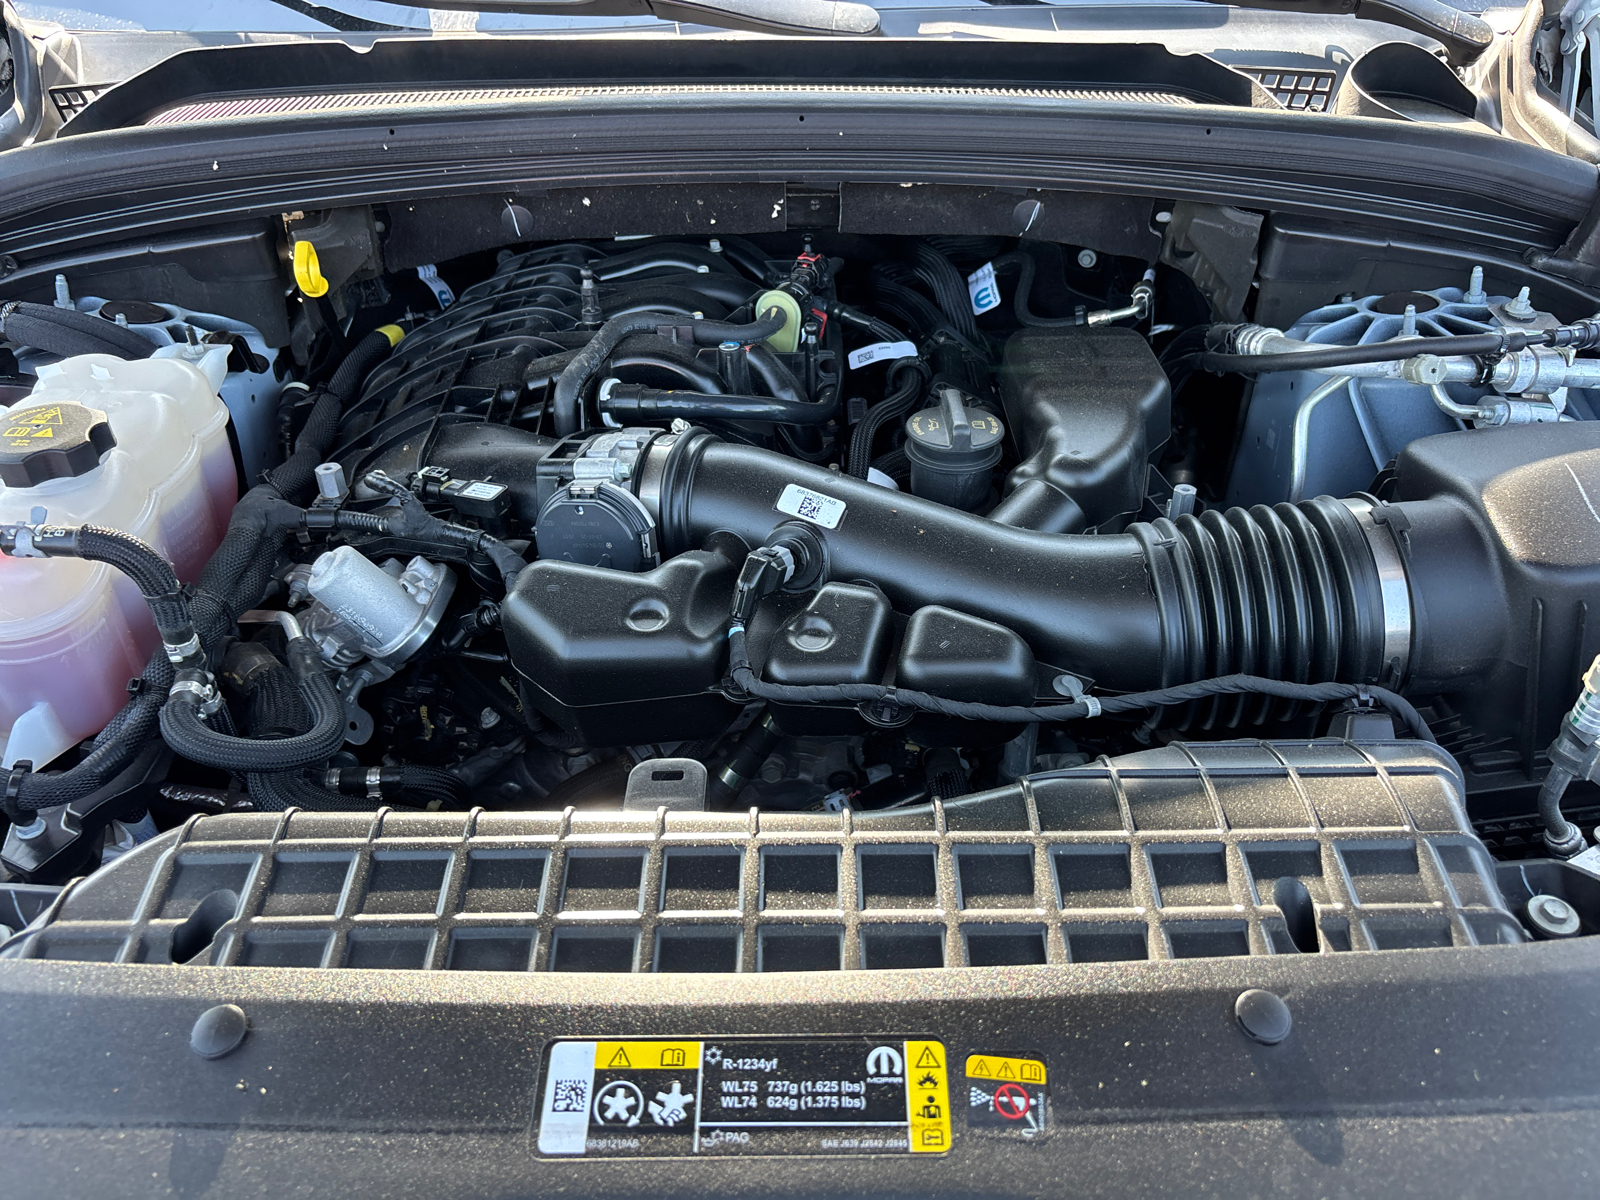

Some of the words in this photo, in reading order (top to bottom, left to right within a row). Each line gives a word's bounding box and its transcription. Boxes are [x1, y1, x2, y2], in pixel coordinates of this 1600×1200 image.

[796, 488, 837, 506] 68376821AB
[722, 1058, 778, 1072] R-1234yf
[866, 1076, 903, 1084] MOPAR
[721, 1080, 758, 1093] WL75
[767, 1081, 799, 1095] 737g
[800, 1080, 838, 1096] (1.625
[841, 1080, 866, 1095] lbs)
[721, 1096, 758, 1108] WL74
[767, 1096, 799, 1110] 624g
[800, 1095, 839, 1111] (1.375
[841, 1095, 867, 1110] lbs)
[725, 1132, 749, 1144] PAG
[821, 1139, 839, 1149] SAE
[840, 1139, 859, 1149] J639
